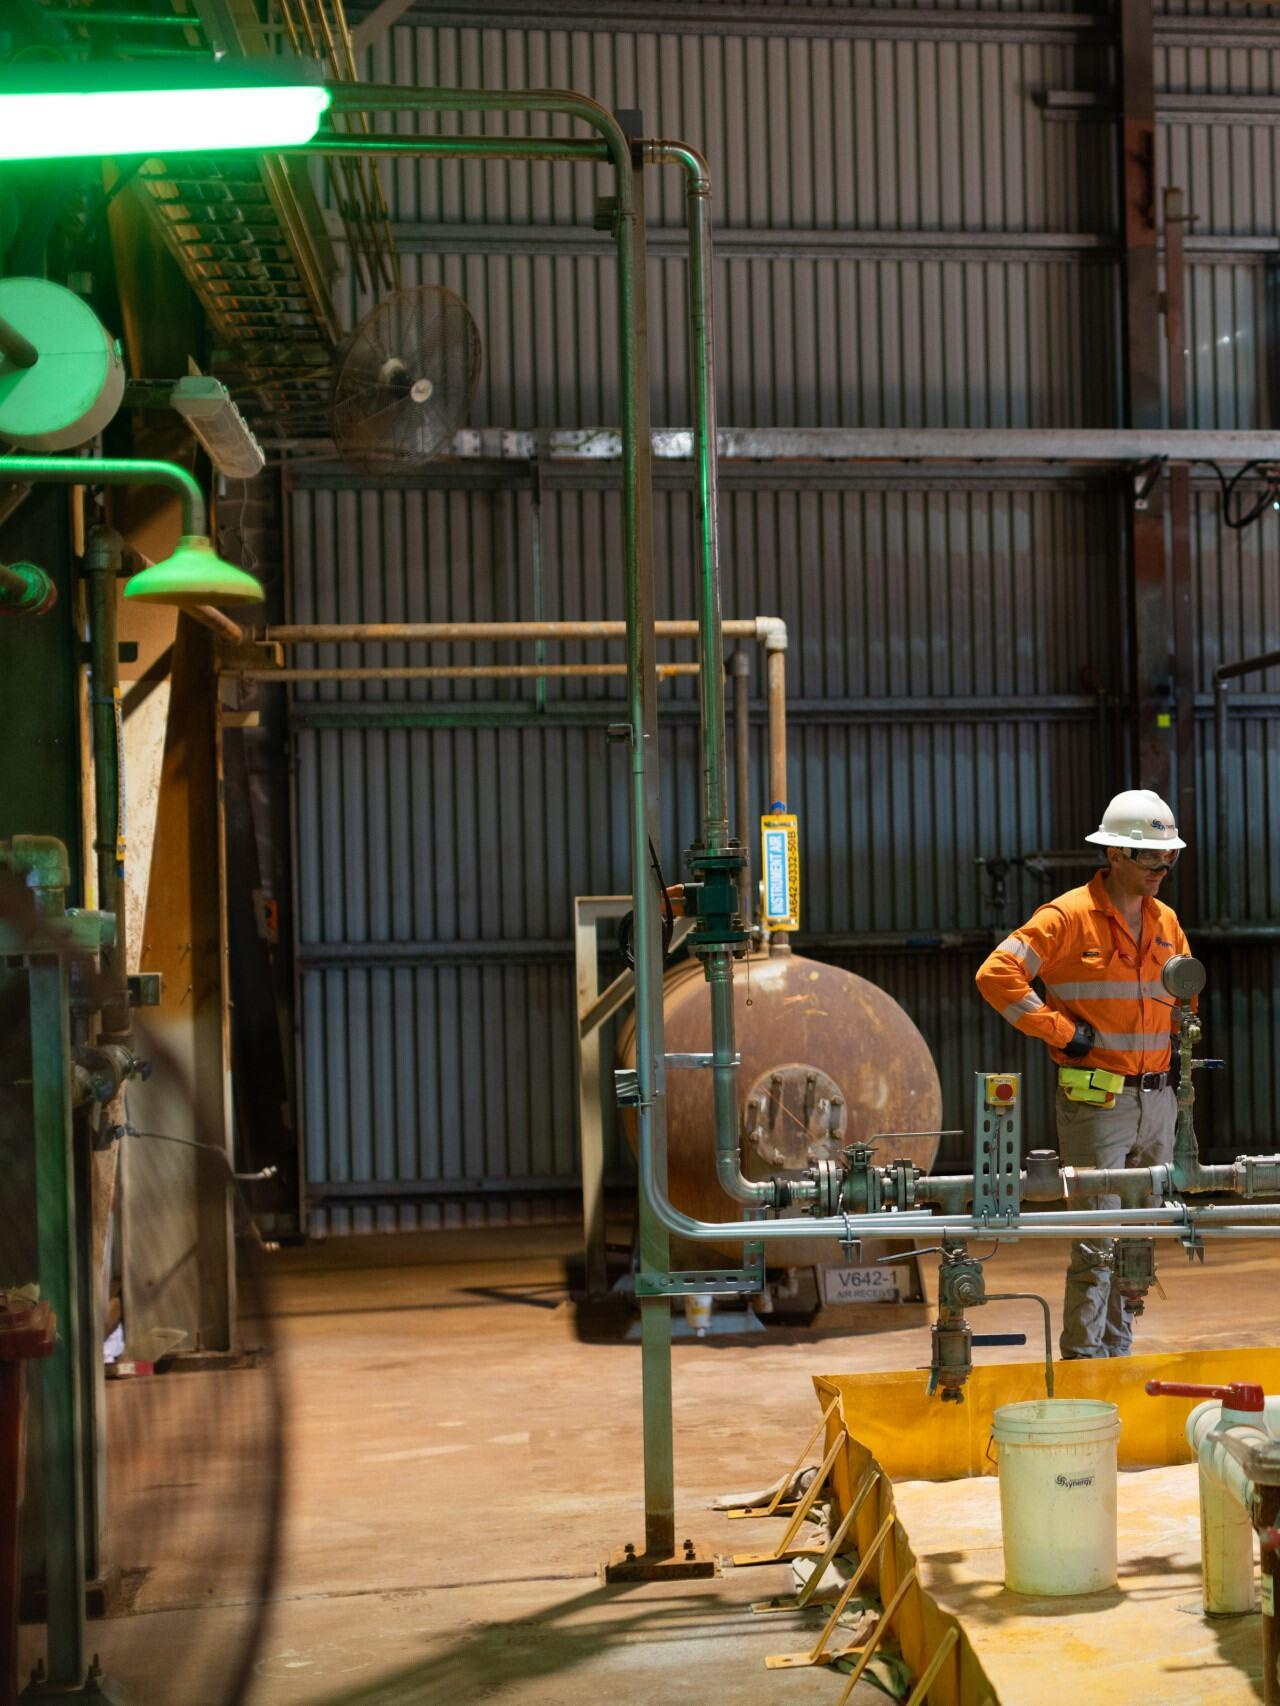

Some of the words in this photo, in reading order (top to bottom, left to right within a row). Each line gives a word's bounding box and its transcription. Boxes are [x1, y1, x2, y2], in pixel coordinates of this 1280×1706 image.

[768, 835, 784, 852] AIR
[769, 853, 785, 914] INSTRUMENT
[838, 1270, 897, 1287] V642-1
[837, 1290, 852, 1299] AIR
[854, 1288, 898, 1299] RECEIVE
